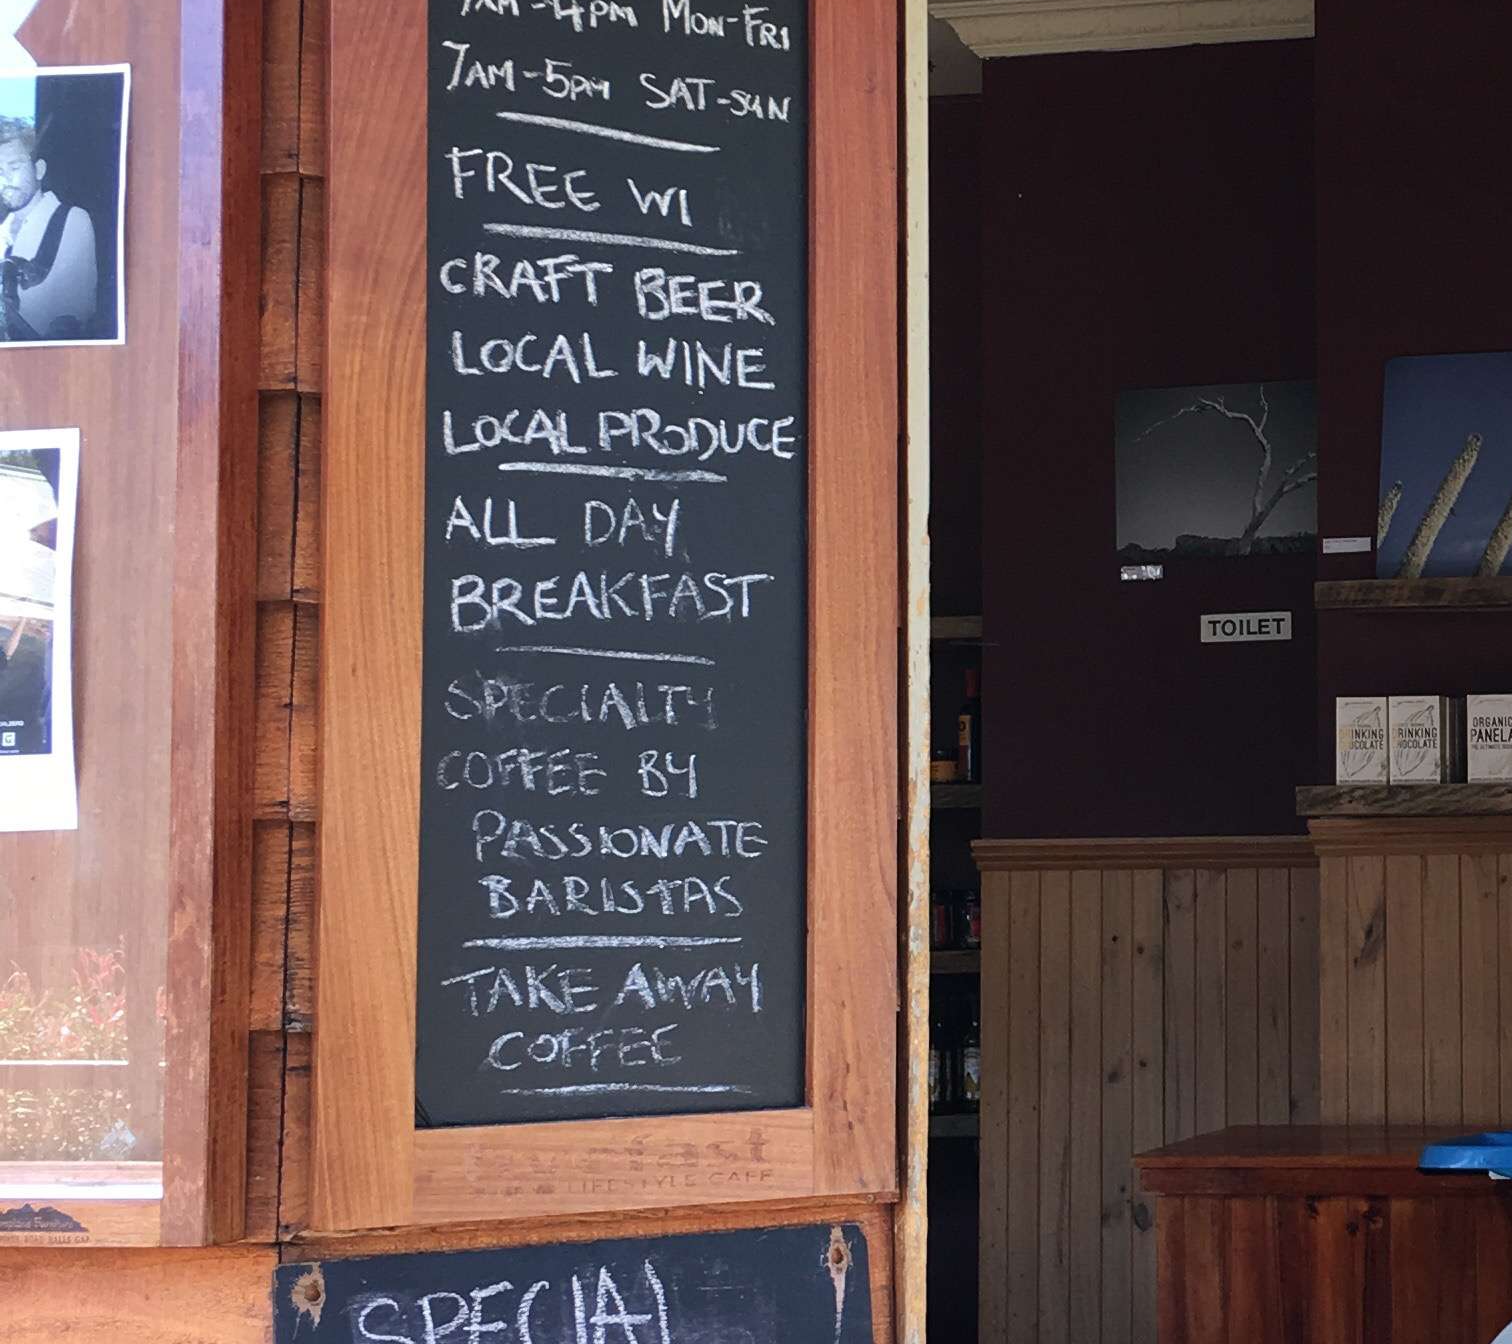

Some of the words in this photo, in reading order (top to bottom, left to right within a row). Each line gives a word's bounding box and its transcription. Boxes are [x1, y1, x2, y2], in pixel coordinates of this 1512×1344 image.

[445, 147, 600, 212] FREE
[627, 178, 693, 227] WI
[440, 251, 614, 307] CRAFT
[634, 267, 777, 327] BEER
[452, 331, 619, 384] LOCAL
[637, 337, 776, 394] WINE
[443, 409, 592, 456] LOCAL
[598, 410, 796, 462] PRODUCE
[445, 495, 557, 547] ALL
[583, 497, 681, 556] DAY
[449, 571, 776, 632] BREAKFAST
[1207, 618, 1286, 638] TOILET
[444, 674, 720, 731] SPECIALTY
[436, 747, 608, 797] COFFEE
[637, 749, 699, 799] BY
[471, 808, 769, 863] PASSIONATE
[478, 874, 744, 920] BARISTAS
[441, 963, 600, 1017] TAKE
[614, 961, 764, 1014] AWAY
[487, 1024, 682, 1072] COFFEE
